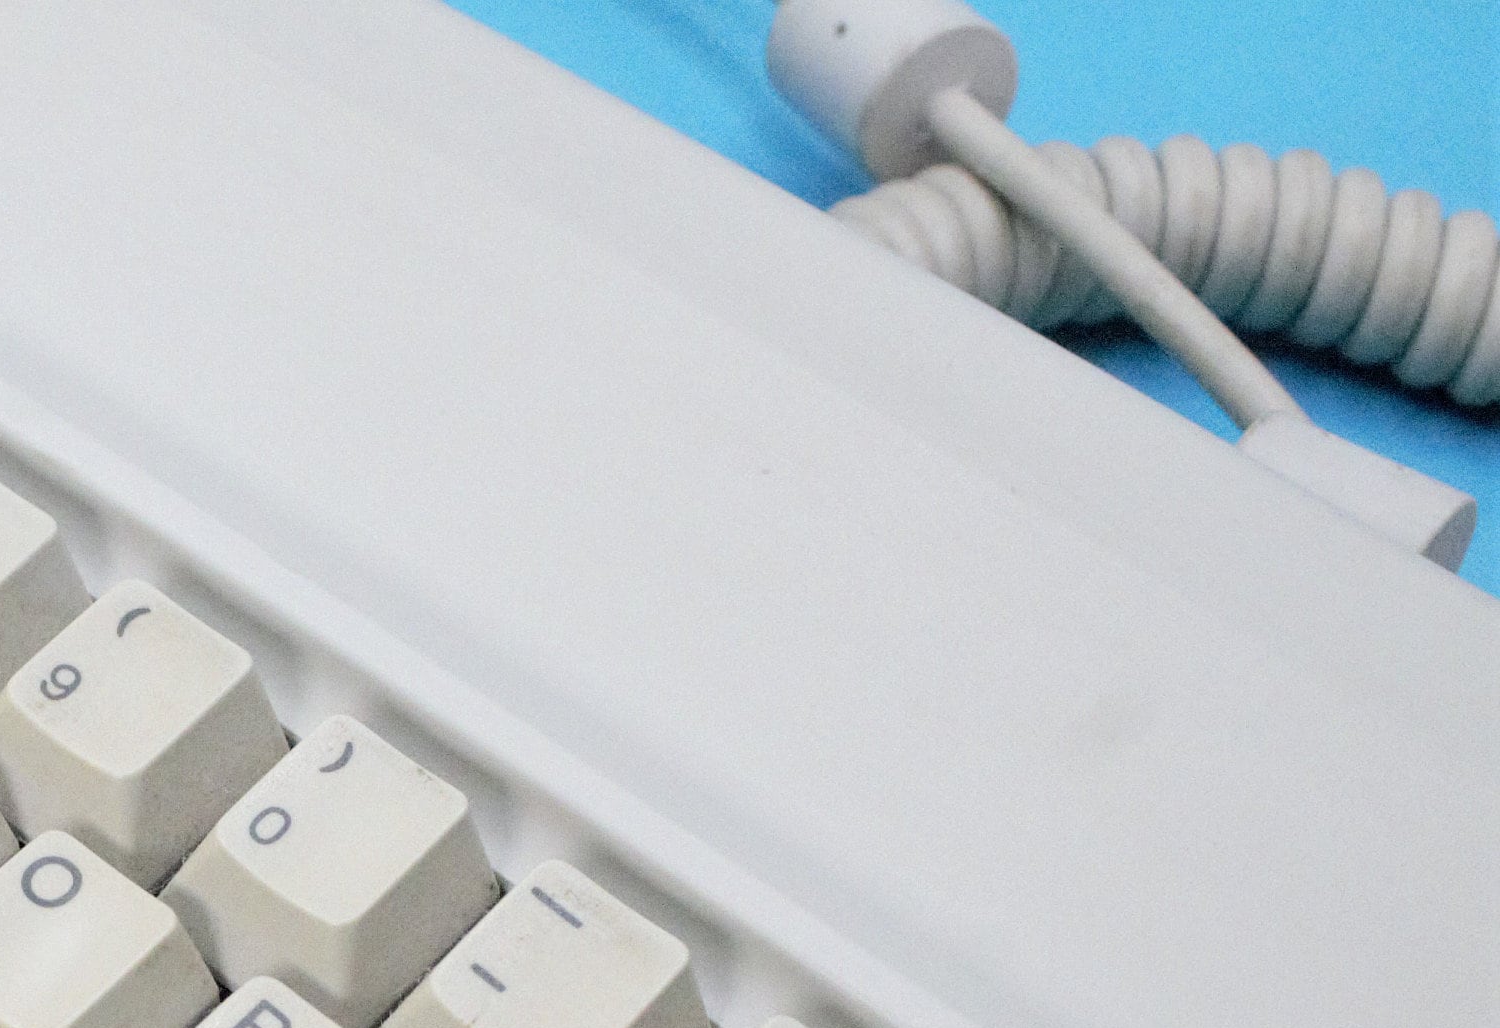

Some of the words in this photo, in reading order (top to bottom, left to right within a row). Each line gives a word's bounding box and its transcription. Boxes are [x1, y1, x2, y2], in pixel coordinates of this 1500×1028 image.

[117, 607, 150, 637] (
[40, 664, 82, 701] 9
[320, 742, 354, 773] )
[22, 857, 81, 907] O
